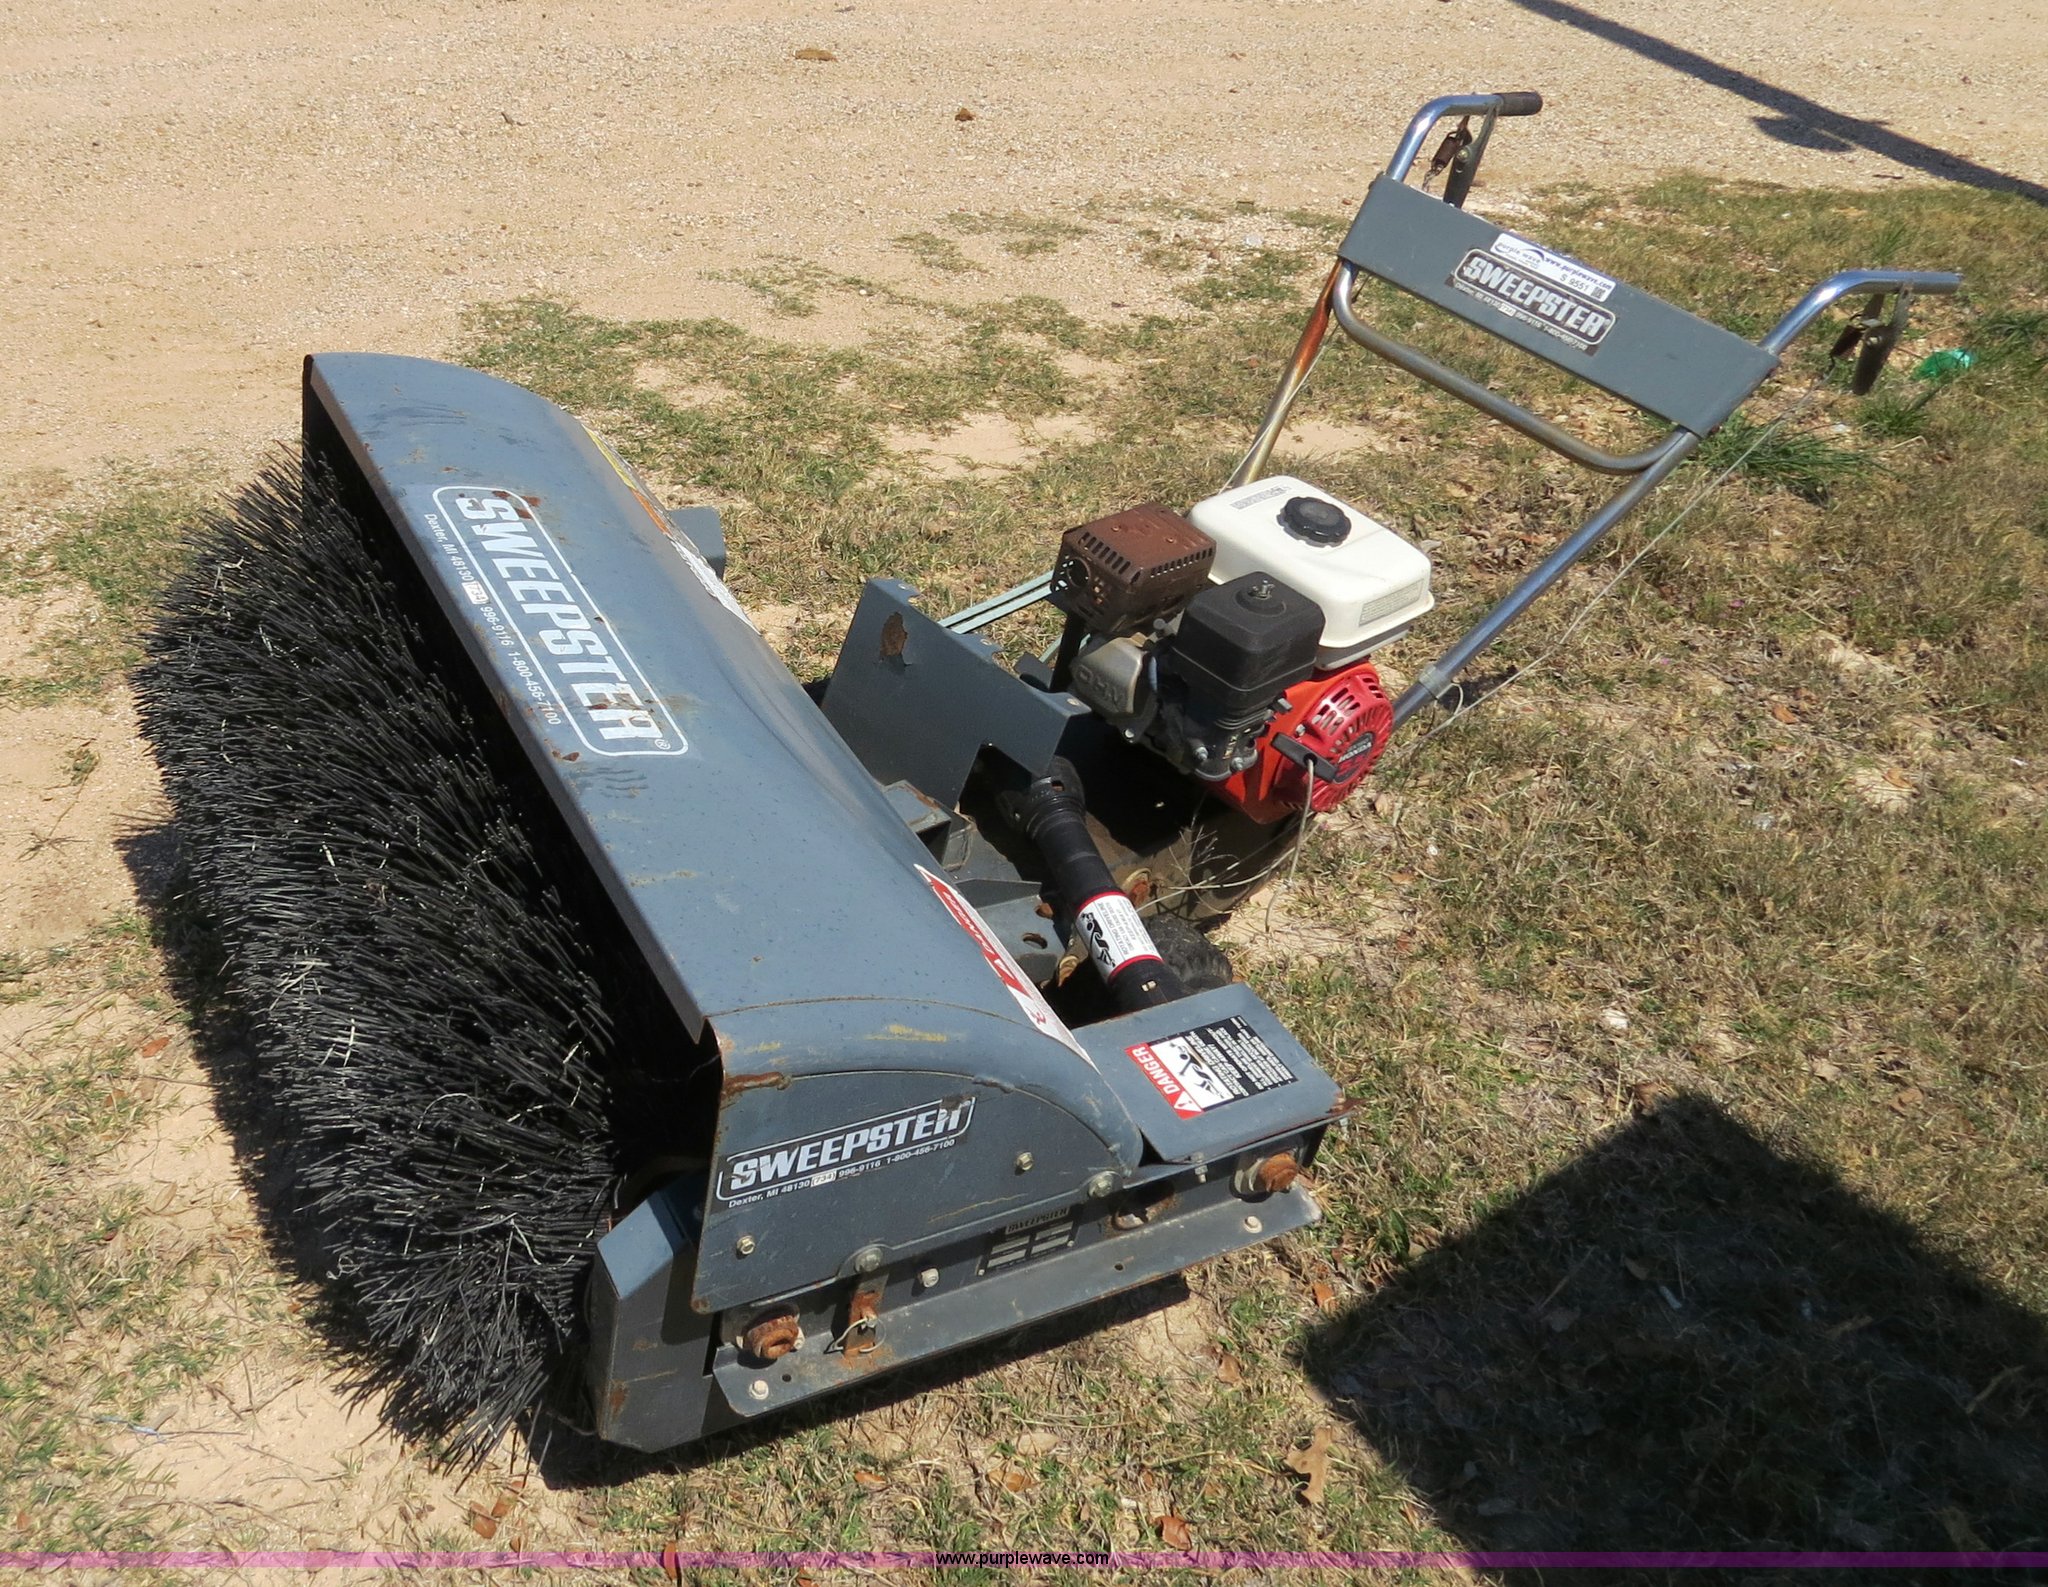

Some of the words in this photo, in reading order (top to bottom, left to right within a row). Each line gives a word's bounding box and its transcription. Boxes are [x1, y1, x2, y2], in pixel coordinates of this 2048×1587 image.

[1463, 256, 1604, 338] SWEEPSTER
[1569, 278, 1589, 291] 9551
[424, 512, 448, 545] Dexter,
[442, 543, 459, 556] MI
[450, 553, 473, 583] 48130
[455, 497, 663, 740] SWEEPSTER
[480, 606, 514, 646] 996-9116
[508, 651, 561, 726] 1-800-456-7100
[1132, 1046, 1180, 1095] DANGER
[729, 1193, 763, 1208] Dexter,
[766, 1187, 779, 1198] MI
[781, 1180, 810, 1195] 48130
[839, 1160, 881, 1177] 996-9116
[886, 1139, 955, 1164] 1-800-456-7100
[730, 1108, 961, 1191] SWEEPSTER
